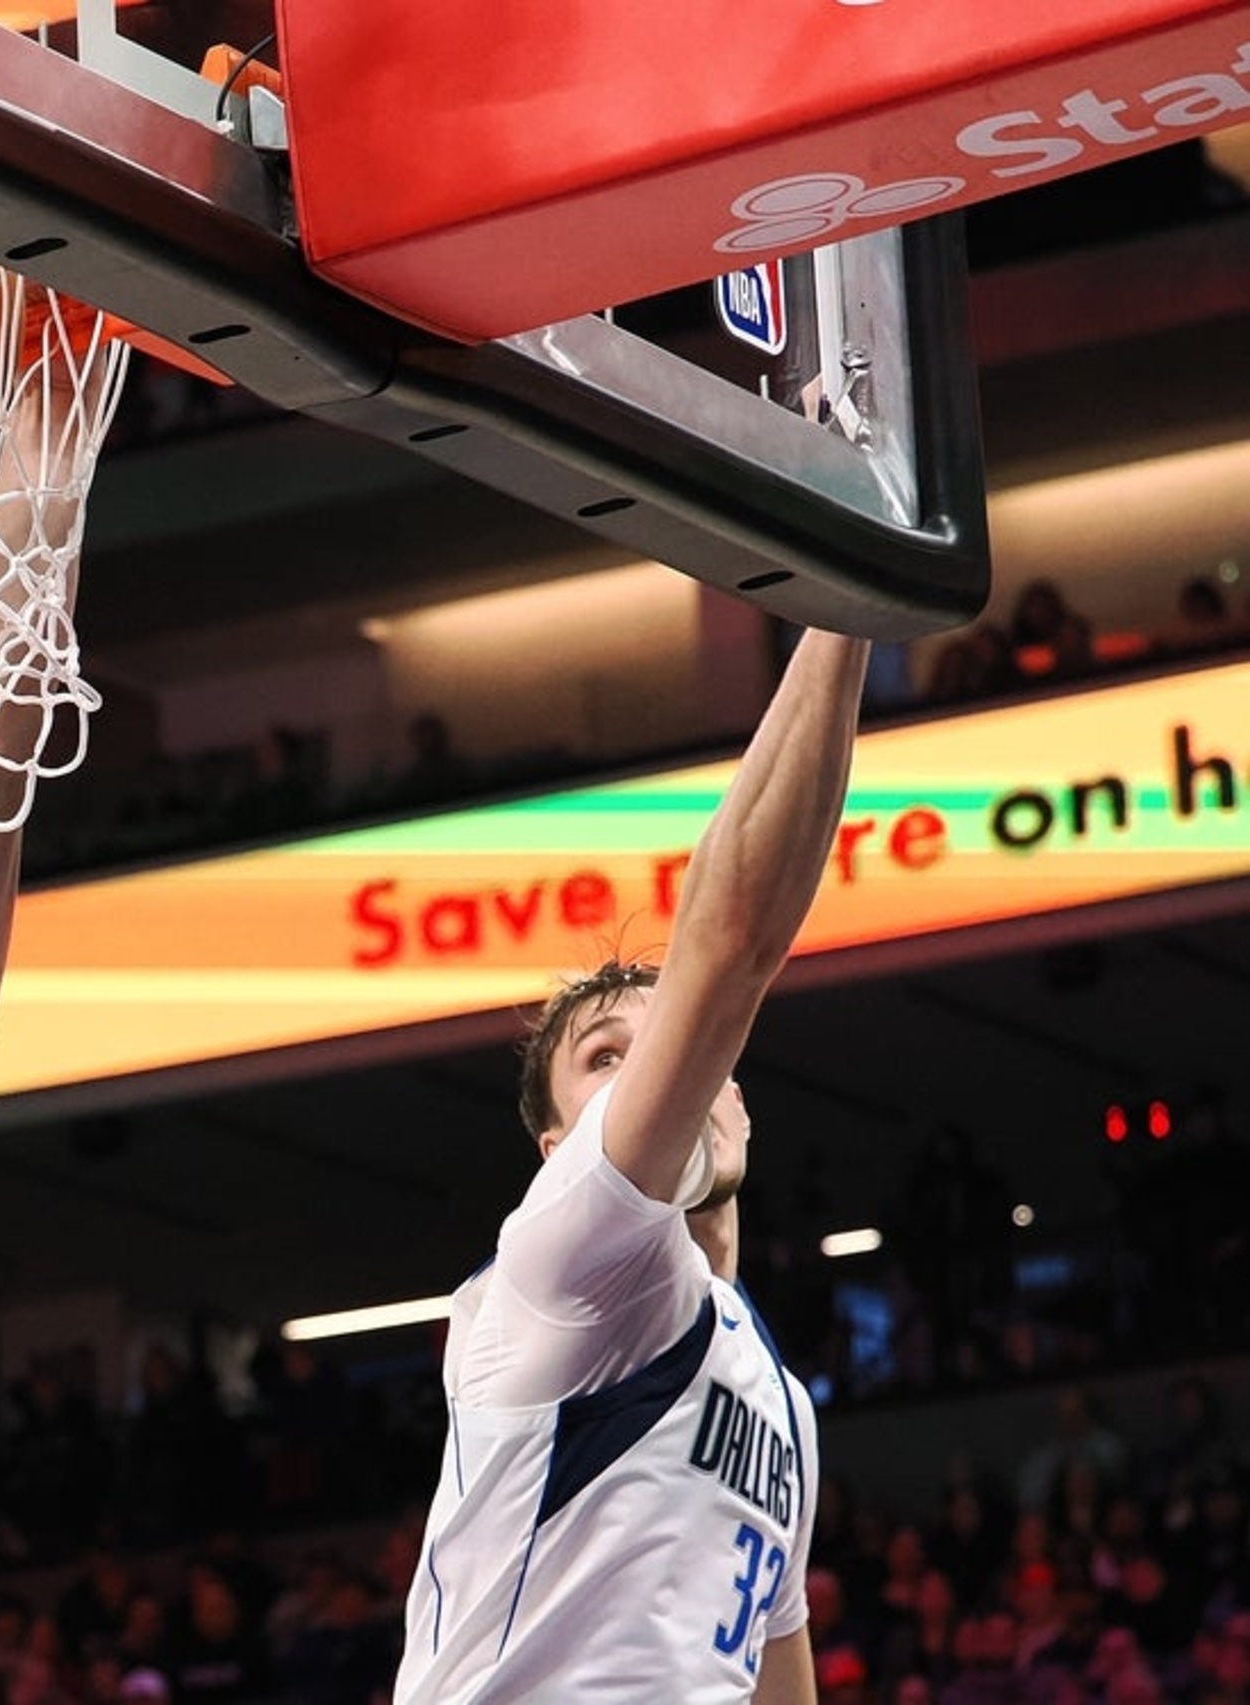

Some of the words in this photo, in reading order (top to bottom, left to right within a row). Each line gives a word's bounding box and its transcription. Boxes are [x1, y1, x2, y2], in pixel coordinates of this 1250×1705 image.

[956, 40, 1250, 178] Sta
[728, 269, 762, 326] NBA
[351, 868, 616, 968] Save
[992, 776, 1127, 848] on
[689, 1376, 794, 1529] DALLAS
